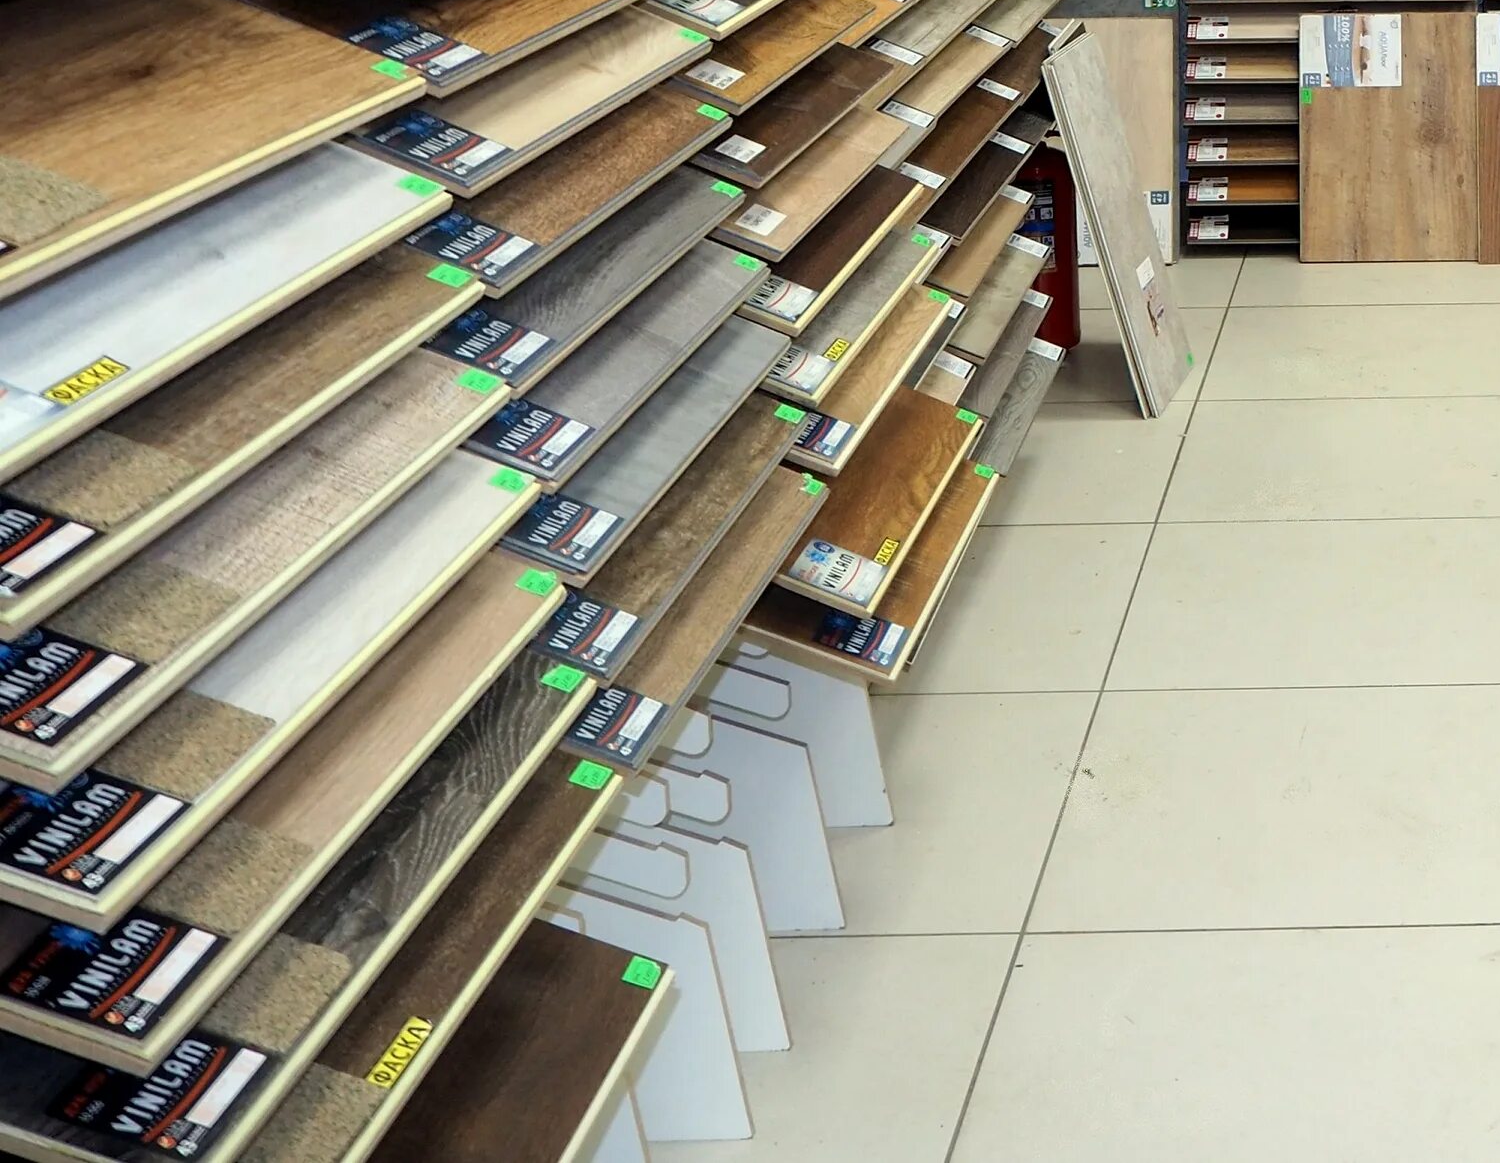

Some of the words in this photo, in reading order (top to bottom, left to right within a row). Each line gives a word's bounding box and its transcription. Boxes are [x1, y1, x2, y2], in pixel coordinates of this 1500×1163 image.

[438, 224, 497, 260] VINILAM
[454, 319, 513, 360] VINILAM
[52, 361, 125, 401] ФАСКА
[496, 408, 553, 453] VINILAM
[527, 500, 582, 546] VINILAM
[548, 601, 602, 651] VINILAM
[575, 688, 627, 742] VINILAM
[14, 782, 125, 866] VINILAM
[57, 917, 160, 1011] VINILAM
[374, 1027, 427, 1082] ФАСКА
[111, 1038, 210, 1136] VINILAM
